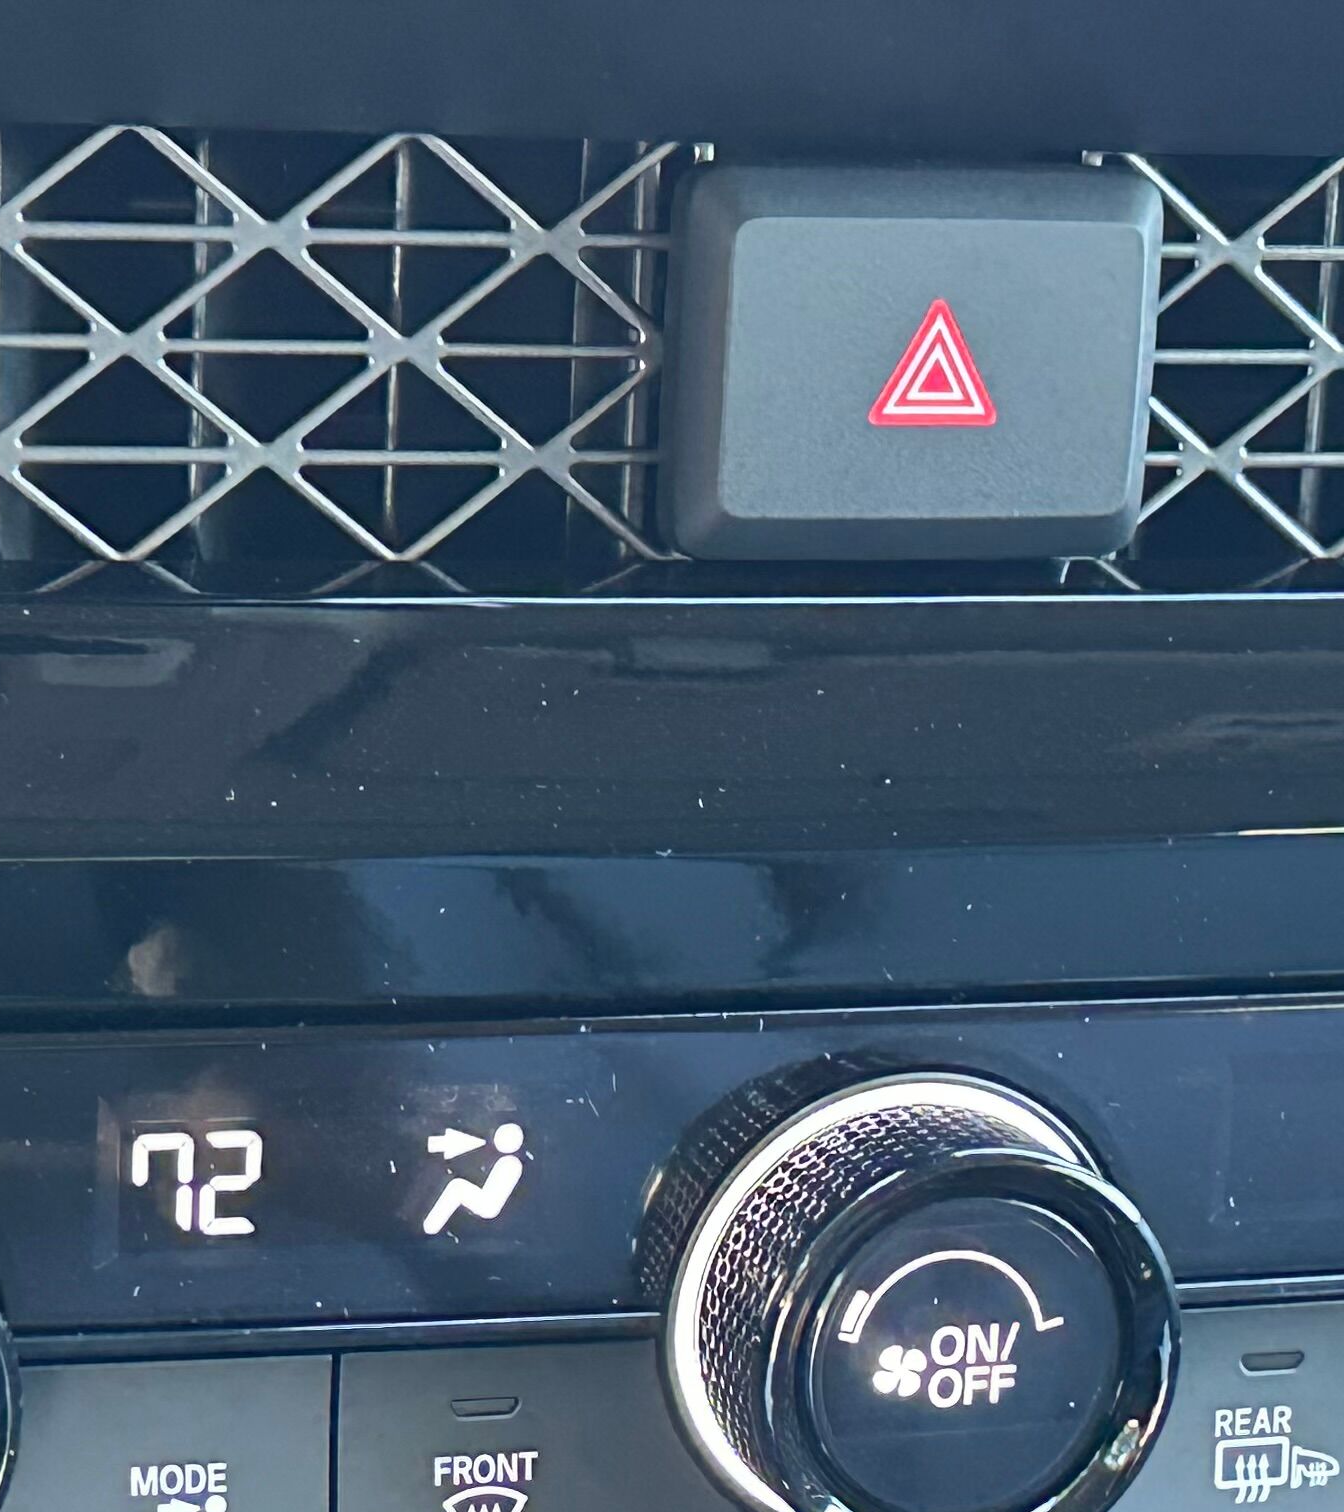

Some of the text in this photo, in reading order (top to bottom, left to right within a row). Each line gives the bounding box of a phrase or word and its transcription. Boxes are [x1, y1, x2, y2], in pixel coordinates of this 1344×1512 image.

[131, 1128, 263, 1236] 72
[930, 1322, 1020, 1367] ON/
[928, 1363, 1017, 1408] OFF
[1216, 1406, 1292, 1438] REAR
[130, 1462, 228, 1498] MODE
[433, 1451, 538, 1488] FRONT
